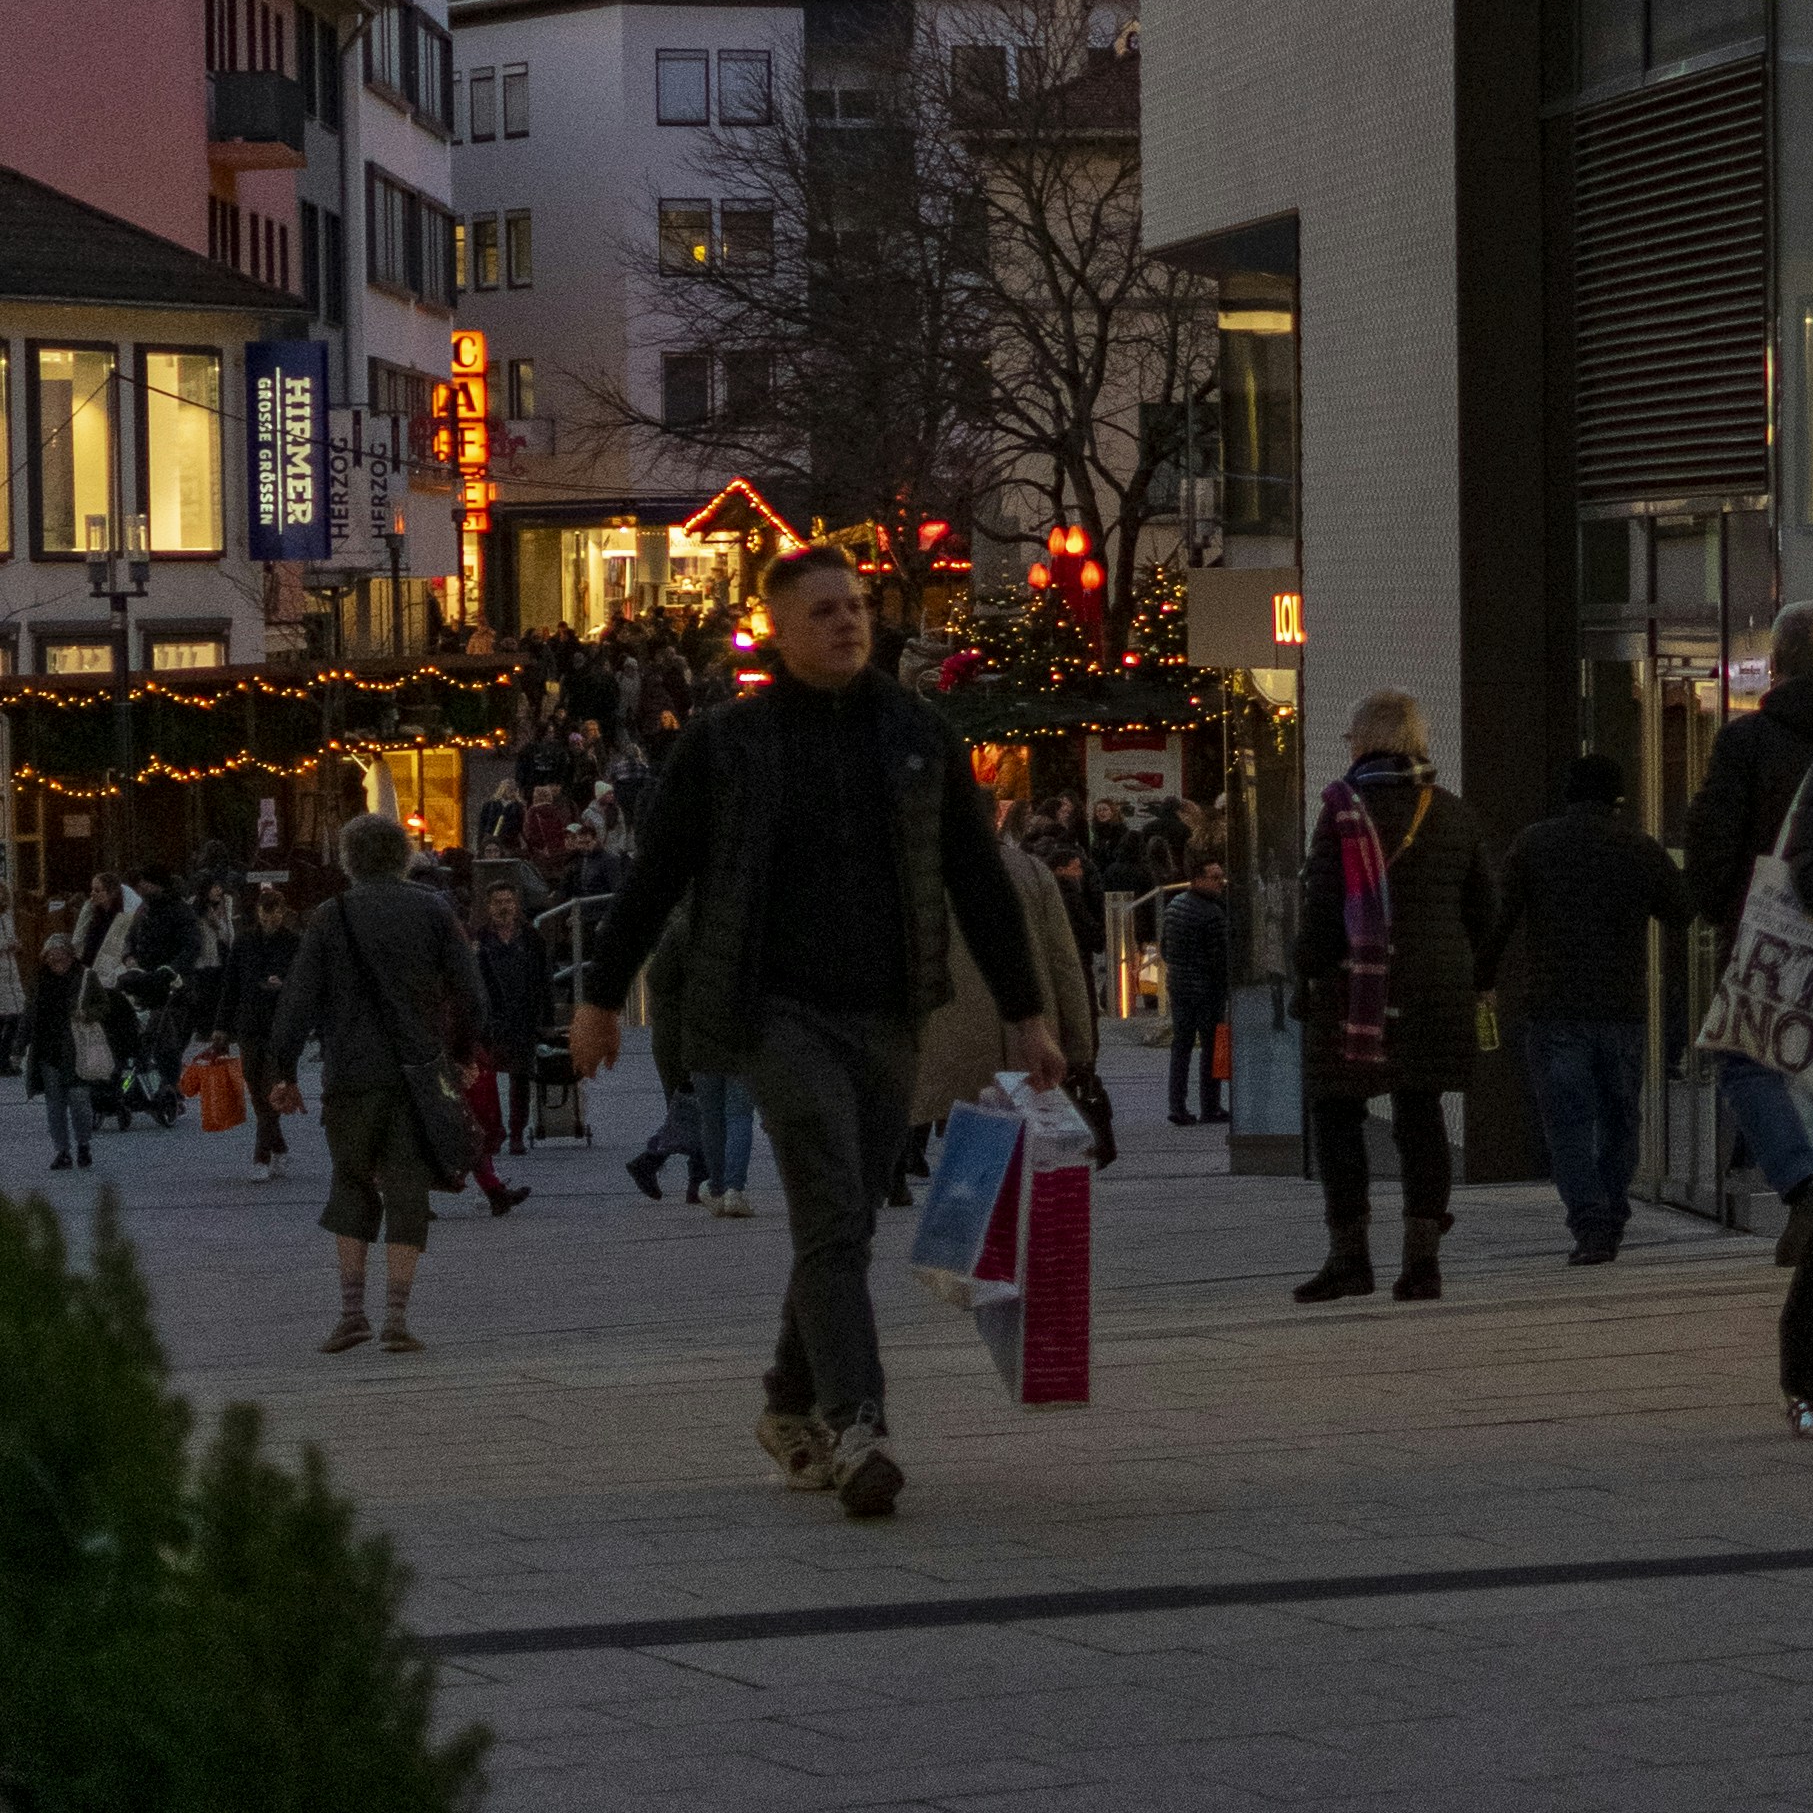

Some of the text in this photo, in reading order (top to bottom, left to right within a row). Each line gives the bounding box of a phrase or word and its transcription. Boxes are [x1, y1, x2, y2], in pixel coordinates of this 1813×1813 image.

[257, 376, 274, 526] GROSSE GRÖSSEN
[285, 376, 313, 525] HIRMER
[330, 437, 350, 540] HERZOG
